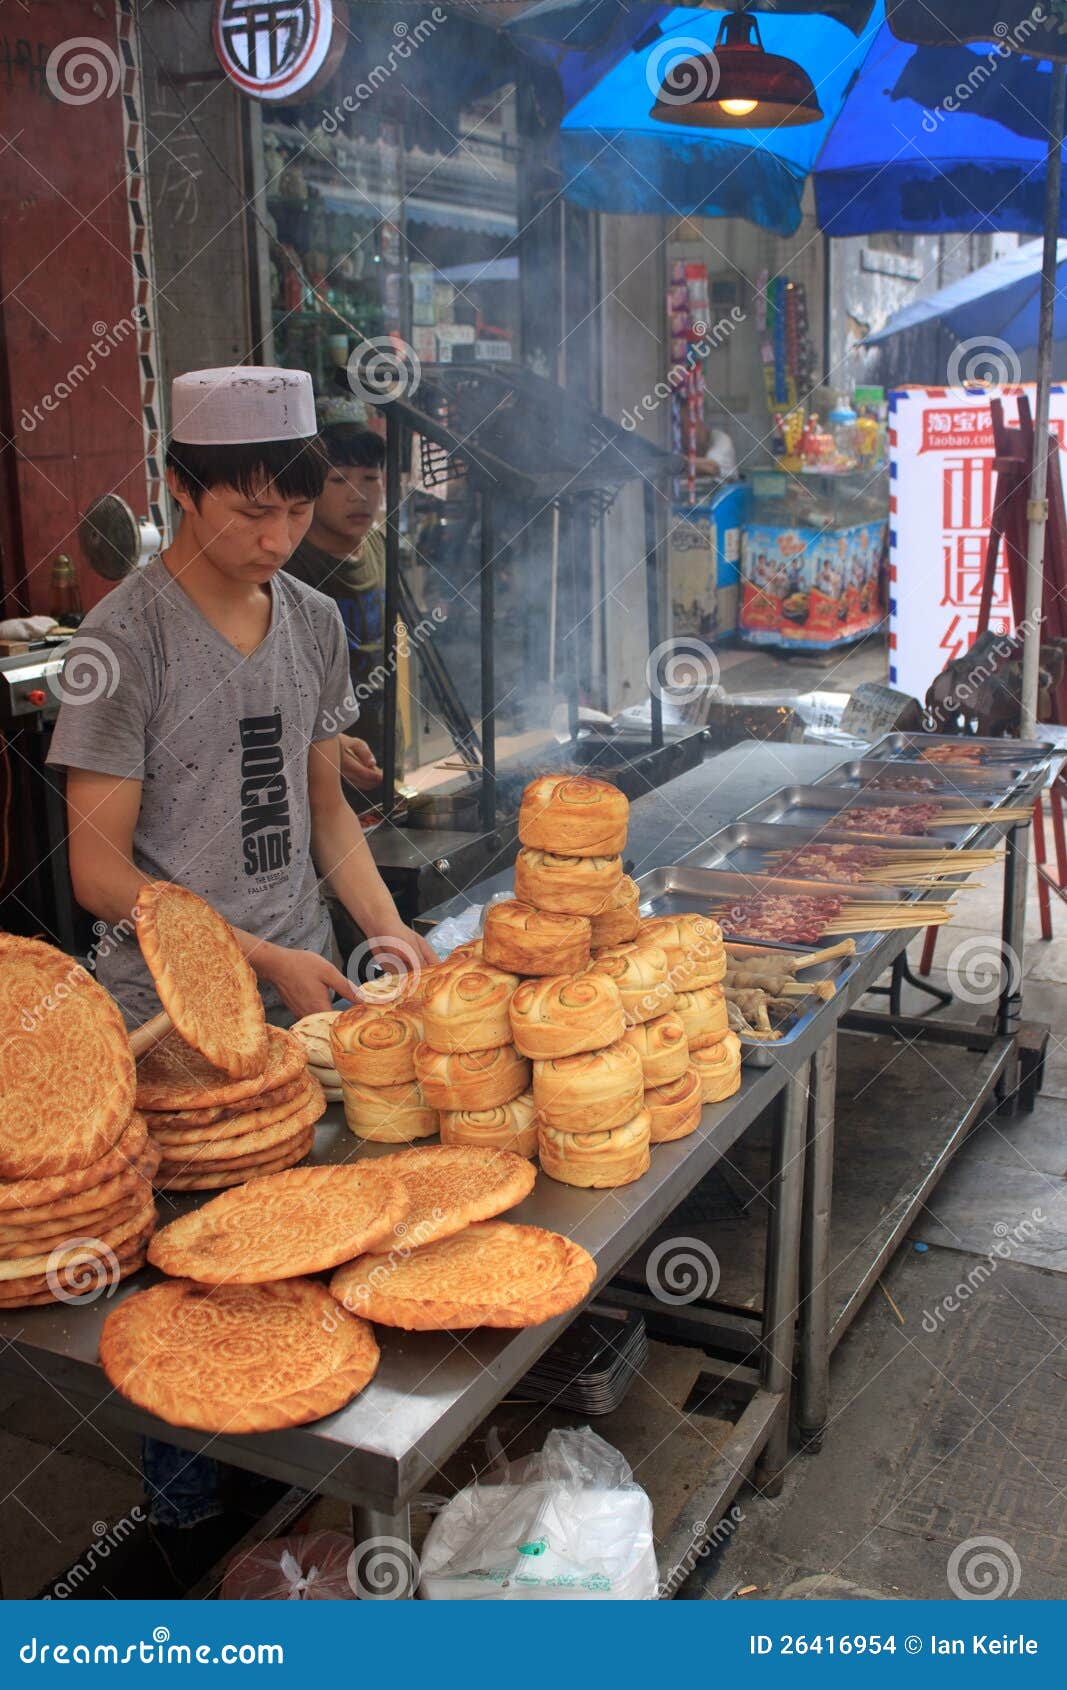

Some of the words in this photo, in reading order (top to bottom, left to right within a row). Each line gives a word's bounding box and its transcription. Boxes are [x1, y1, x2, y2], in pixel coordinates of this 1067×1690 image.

[928, 411, 992, 433] 淘宝网
[239, 713, 290, 839] DOCK
